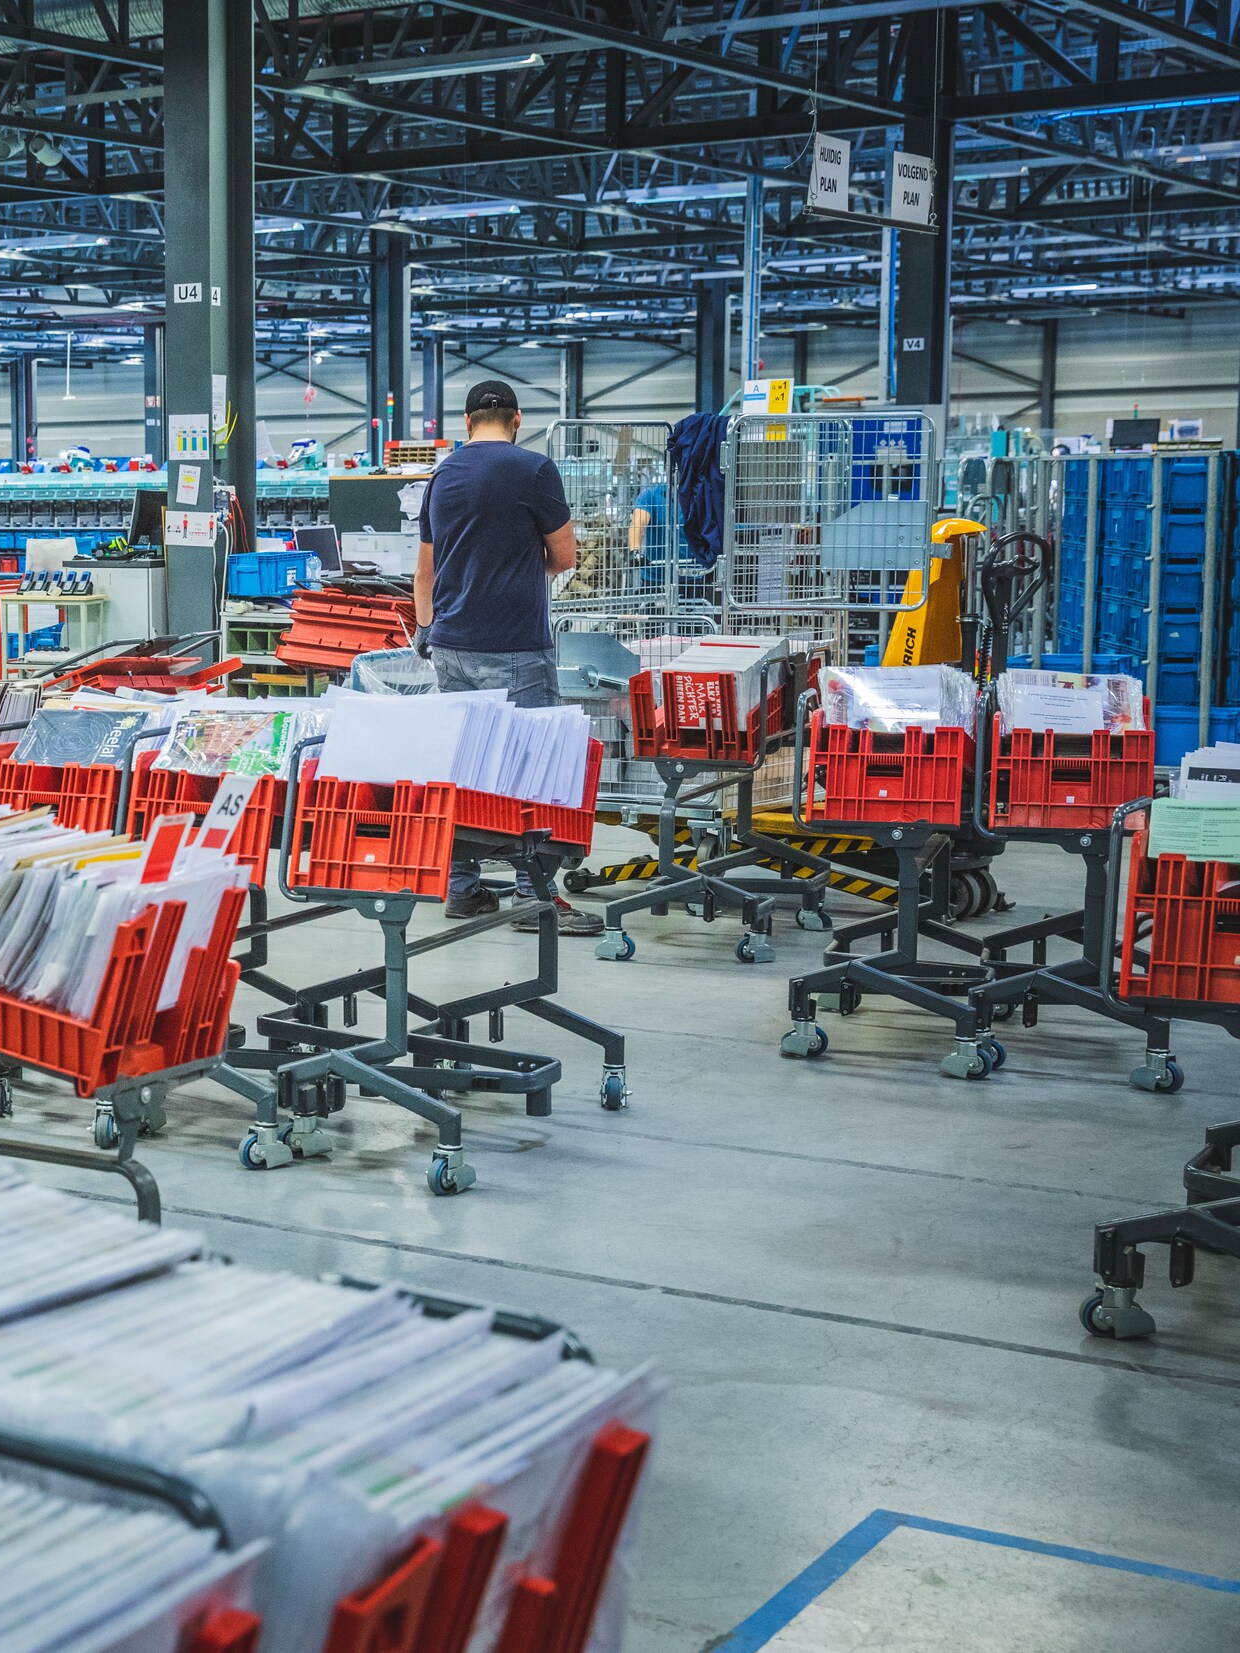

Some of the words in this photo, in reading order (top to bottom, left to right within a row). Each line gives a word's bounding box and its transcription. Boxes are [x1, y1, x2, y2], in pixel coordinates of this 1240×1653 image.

[820, 147, 842, 165] HUIDIG
[898, 163, 929, 181] VOLGEND
[820, 177, 837, 193] PLAN
[903, 191, 920, 206] PLAN
[178, 285, 198, 300] U4
[906, 340, 921, 349] V4
[902, 626, 917, 666] RICH
[684, 675, 699, 720] DICHTER
[695, 683, 706, 713] MAAK
[678, 704, 686, 723] DAN
[98, 719, 125, 758] Heelal
[217, 793, 244, 816] AS
